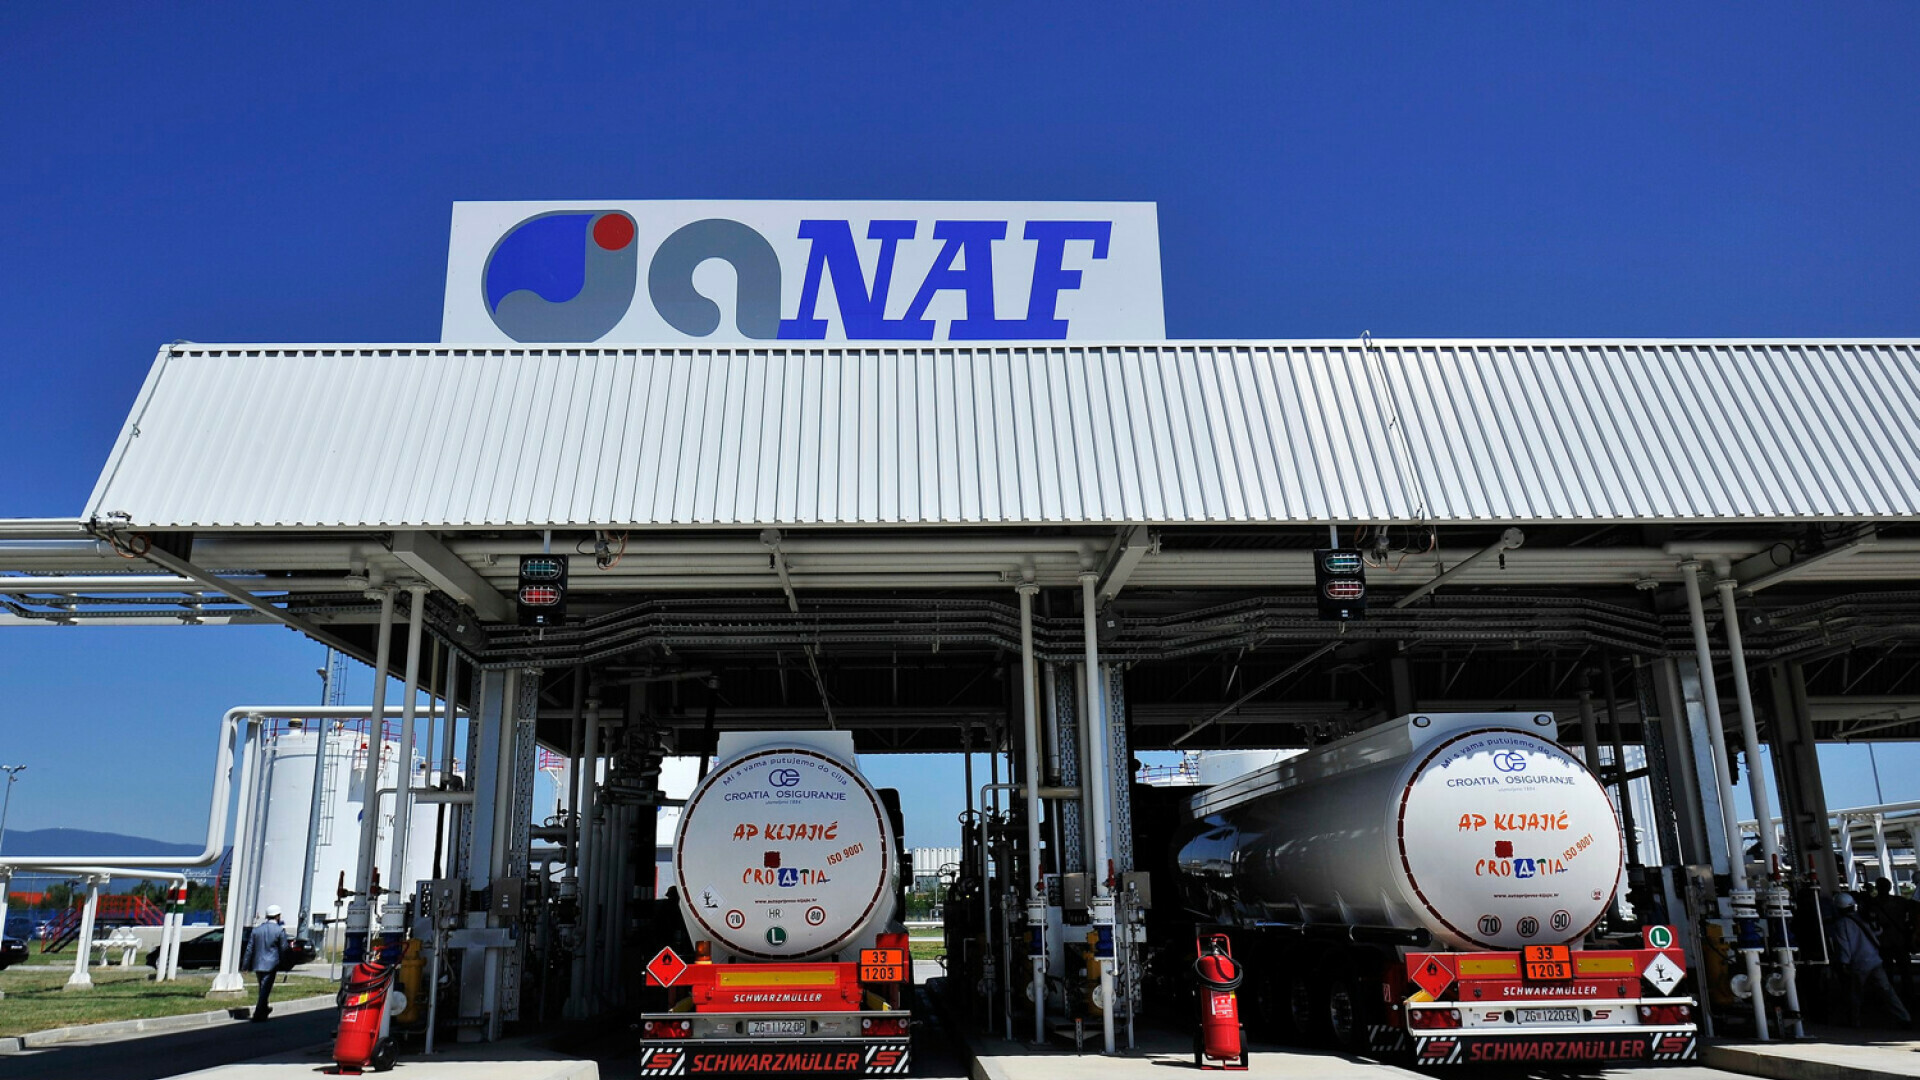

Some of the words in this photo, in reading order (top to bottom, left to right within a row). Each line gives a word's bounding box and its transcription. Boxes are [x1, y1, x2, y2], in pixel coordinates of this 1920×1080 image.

[1460, 741, 1484, 755] vama
[1487, 738, 1534, 749] putujemo
[743, 760, 767, 772] vama
[770, 757, 815, 767] putujemo
[817, 764, 829, 773] do
[1447, 776, 1500, 788] CROATIA
[1506, 775, 1575, 786] OSIGURANJE
[724, 790, 770, 802] CROATIA
[776, 790, 847, 801] OSIGURANJE
[1458, 813, 1487, 832] AP
[1494, 810, 1569, 832] KLJAJIĆ
[732, 823, 759, 841] AP
[764, 821, 838, 841] KLJAJIĆ
[826, 851, 843, 866] ISO
[842, 842, 864, 859] 9001
[1562, 846, 1578, 862] ISO
[1576, 833, 1595, 852] 9001
[1475, 858, 1568, 879] CROATIA
[742, 867, 831, 887] CROATIA
[730, 914, 741, 924] 70
[768, 908, 782, 919] HR
[810, 911, 821, 921] 80
[1554, 913, 1568, 929] 90
[1482, 918, 1498, 933] 70
[1521, 920, 1536, 934] 80
[771, 928, 783, 944] L
[1655, 930, 1667, 945] L
[872, 951, 887, 963] 33
[1536, 946, 1555, 960] 33
[864, 967, 895, 980] 1203
[1531, 963, 1565, 978] 1203
[733, 993, 823, 1003] SCHWARZMÜLLER
[1503, 986, 1598, 996] SCHWARZMÜLLER
[1524, 1010, 1537, 1022] ZG
[754, 1022, 765, 1033] ZG
[1469, 1040, 1645, 1061] SCHWARZMÜLLER
[691, 1053, 860, 1072] SCHWARZMÜLLER
